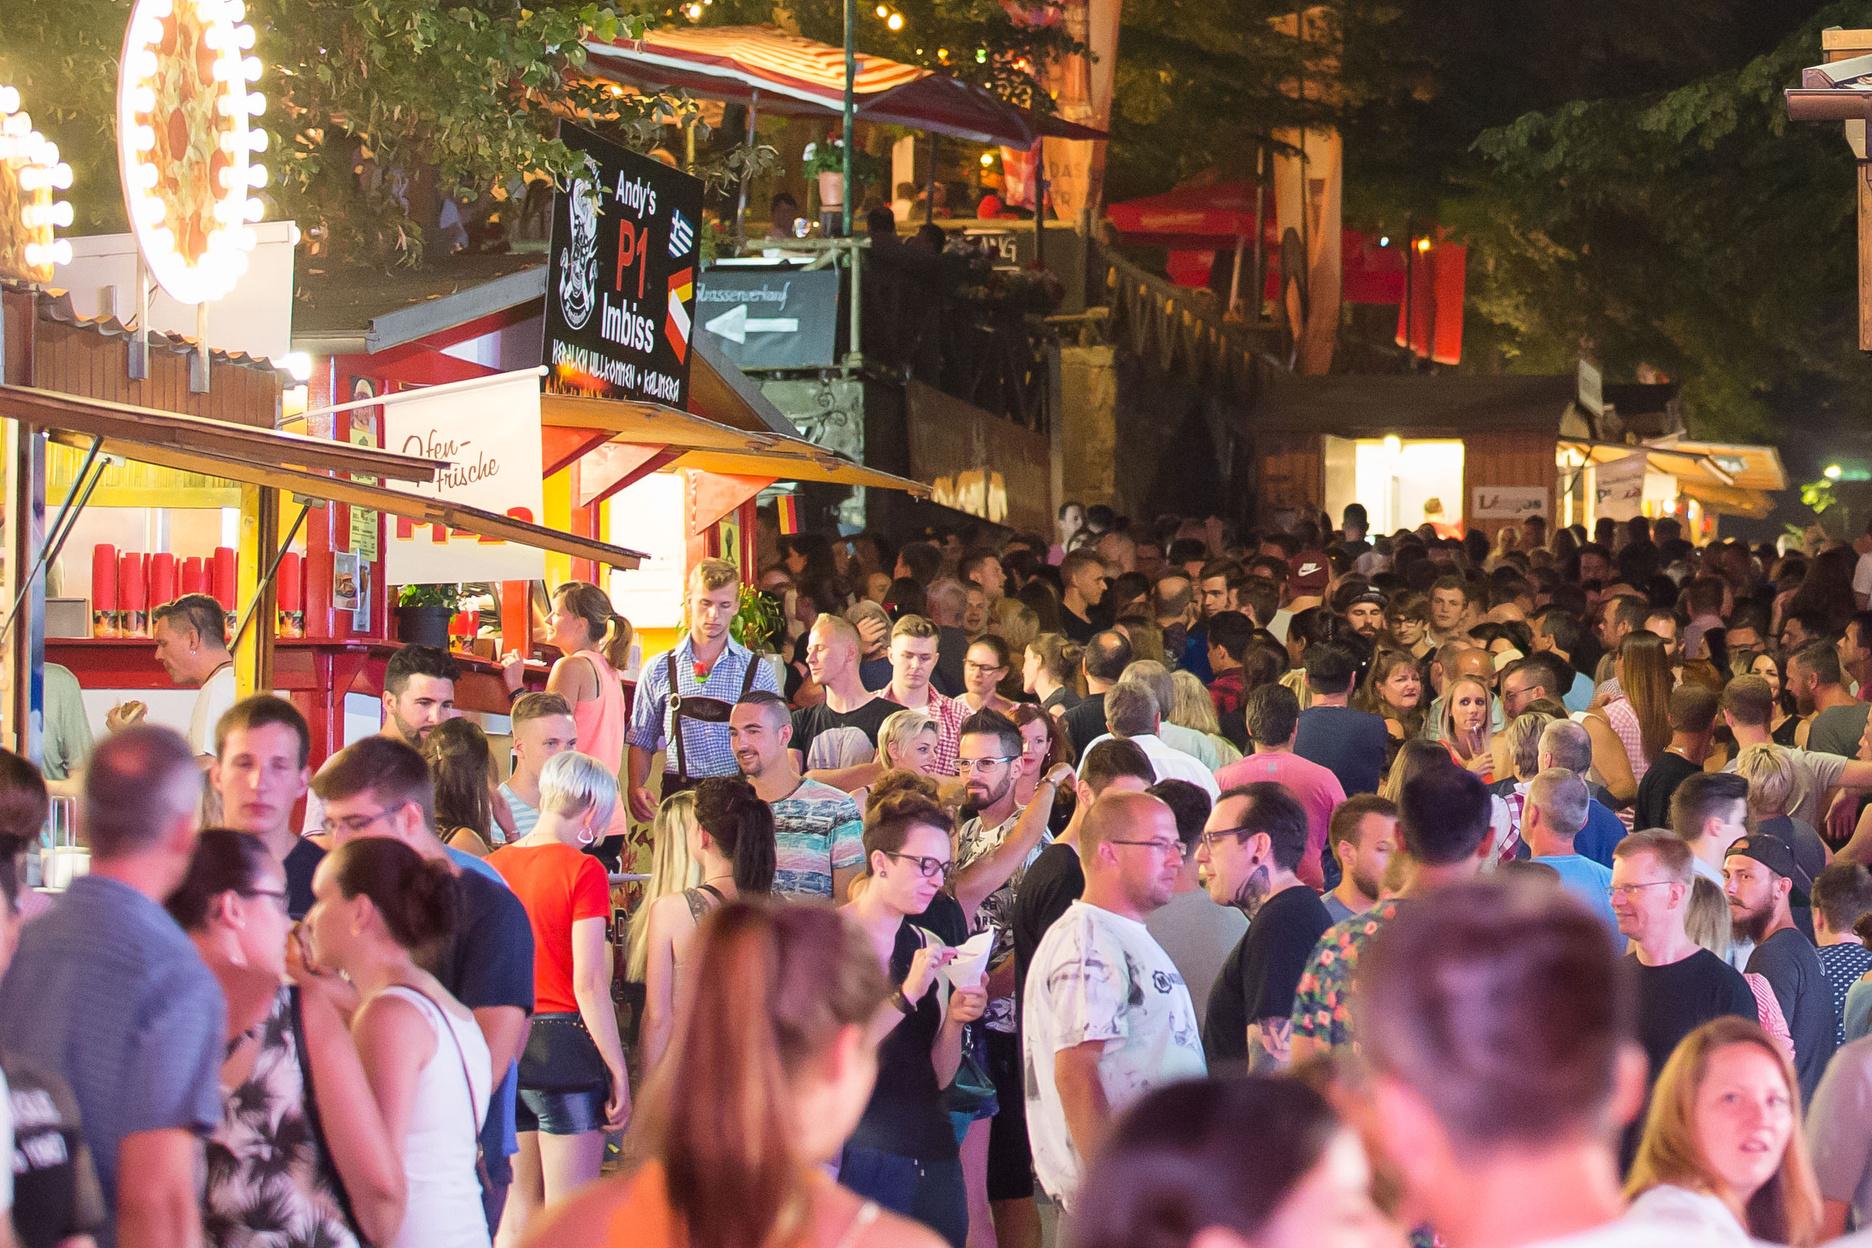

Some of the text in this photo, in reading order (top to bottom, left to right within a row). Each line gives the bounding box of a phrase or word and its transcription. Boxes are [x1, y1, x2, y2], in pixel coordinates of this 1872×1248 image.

[615, 169, 657, 220] Andy's
[615, 218, 648, 300] P1
[601, 291, 655, 354] Imbiss
